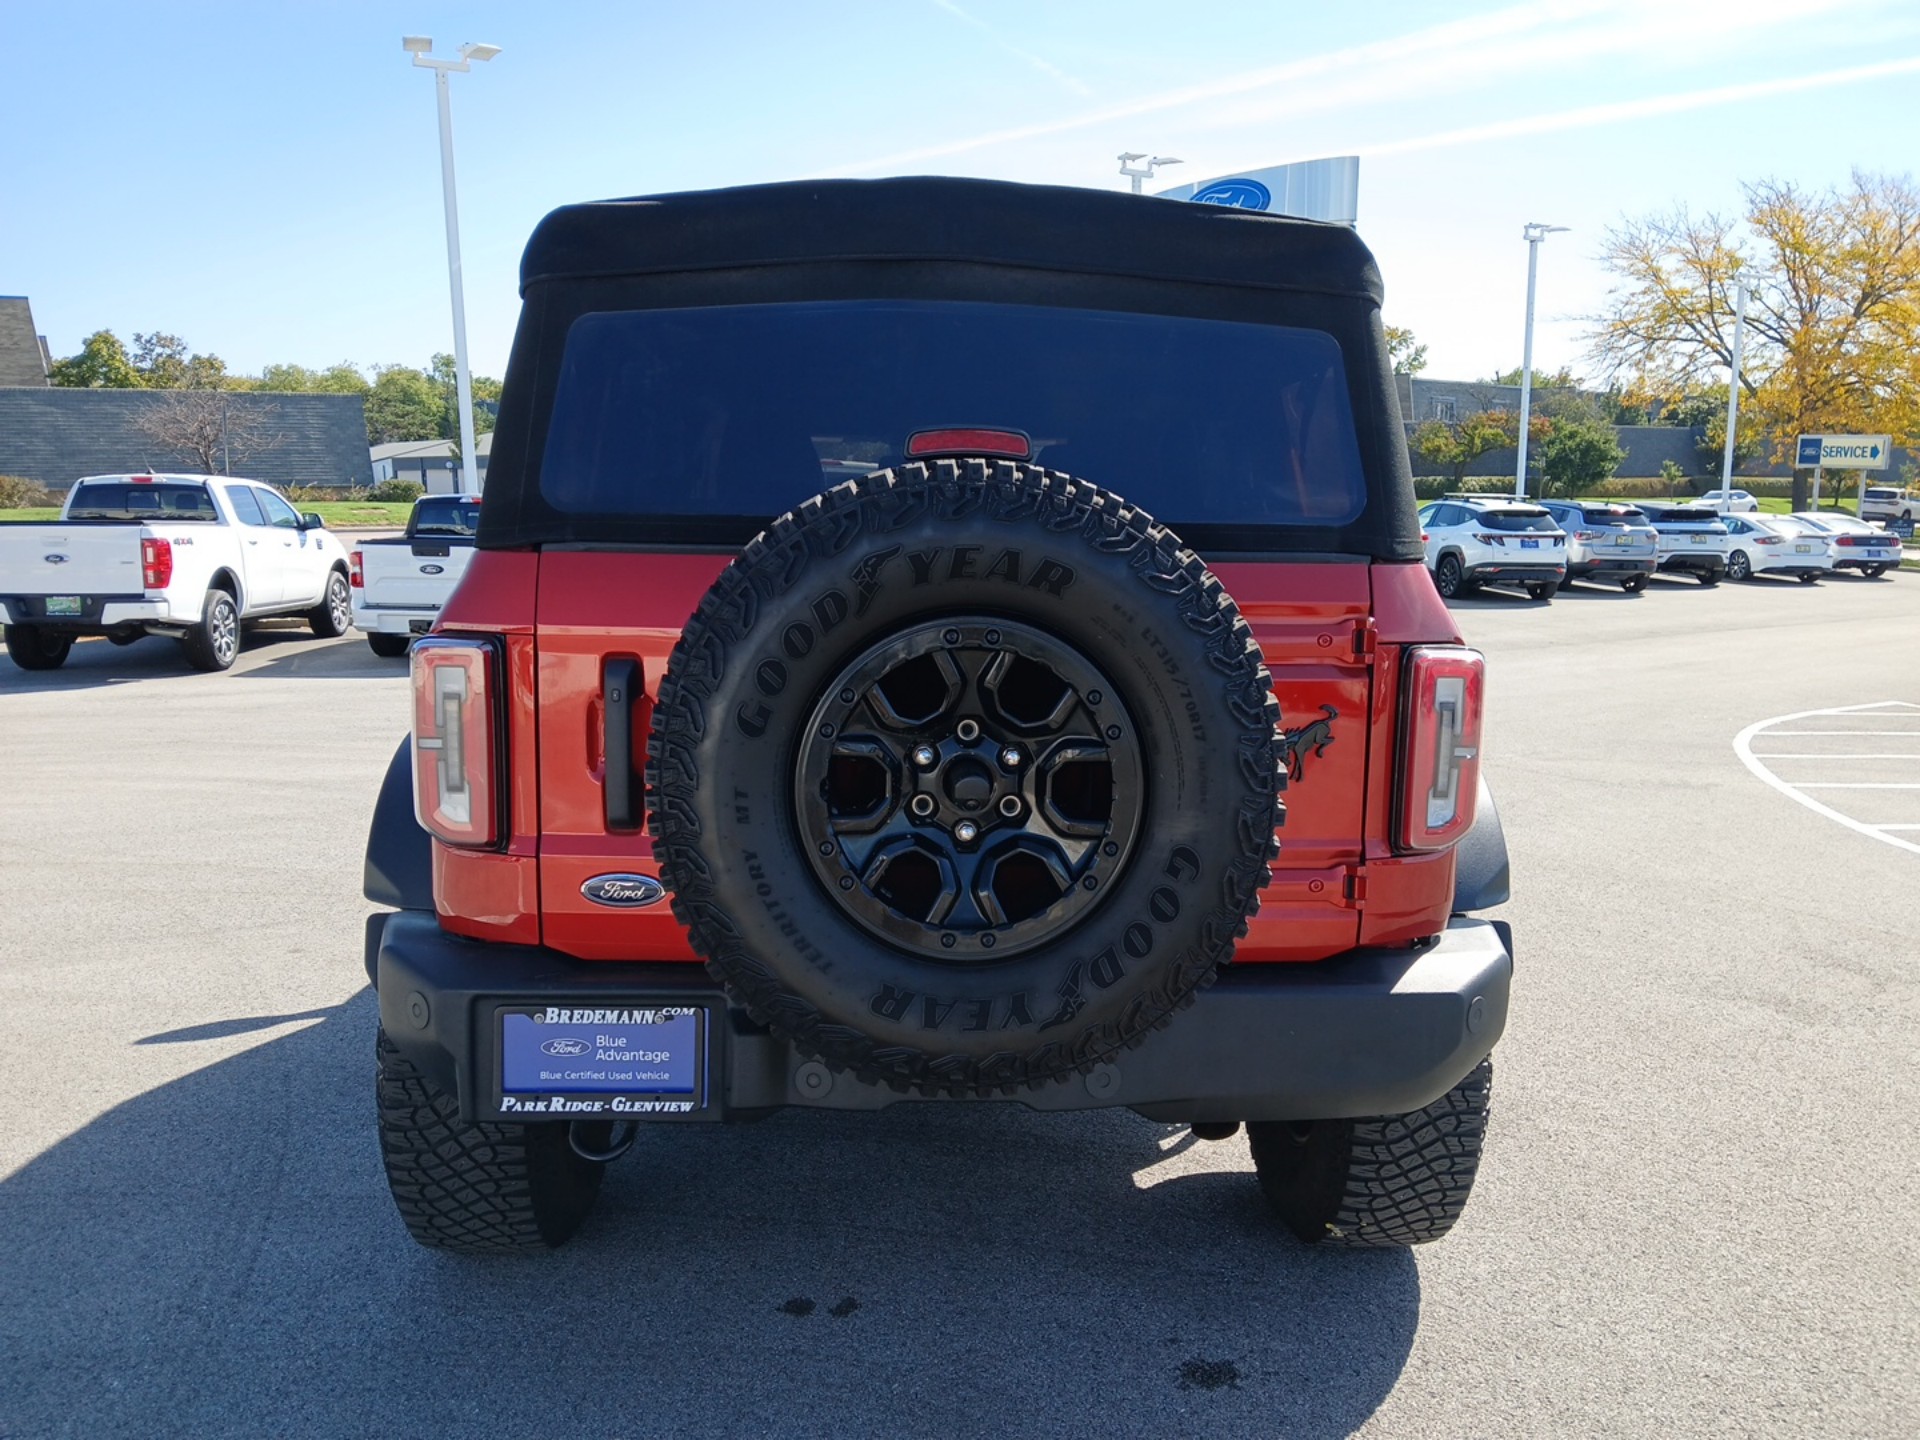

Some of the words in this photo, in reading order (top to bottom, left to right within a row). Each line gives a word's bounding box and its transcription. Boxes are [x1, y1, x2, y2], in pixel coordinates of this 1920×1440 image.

[1822, 446, 1869, 458] SERVICE
[735, 786, 751, 825] MT
[600, 880, 645, 899] Ford
[743, 850, 834, 976] TERRITORY
[596, 1035, 627, 1047] Blue
[596, 1049, 670, 1063] Advantage
[540, 1071, 561, 1080] Blue
[564, 1070, 605, 1080] Certified
[608, 1071, 633, 1080] Used
[636, 1071, 670, 1080] Vehicle
[500, 1097, 549, 1112] PARK
